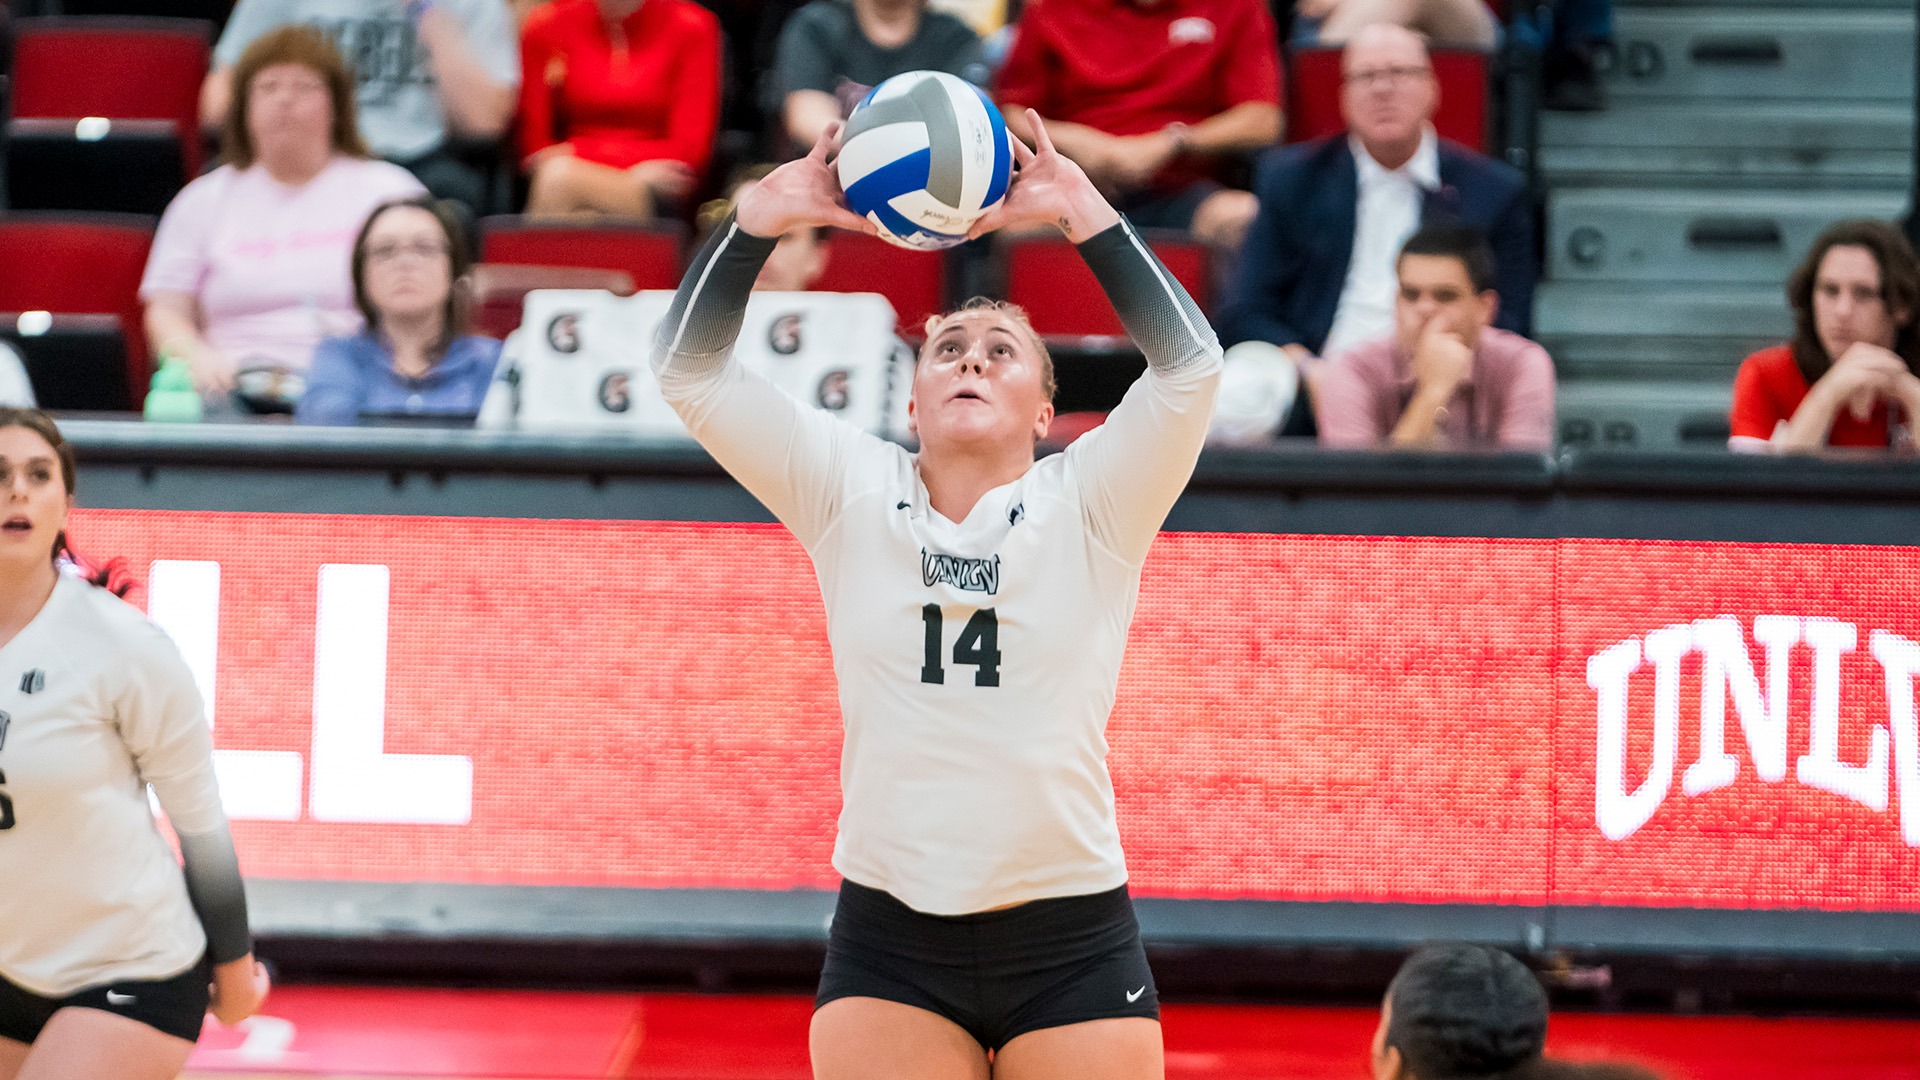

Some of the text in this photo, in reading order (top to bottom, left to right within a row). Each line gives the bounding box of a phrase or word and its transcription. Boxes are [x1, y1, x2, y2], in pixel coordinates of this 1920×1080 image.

[547, 312, 582, 353] G
[768, 312, 806, 355] G
[598, 370, 634, 413] G
[921, 546, 1001, 595] UNLV
[921, 602, 1001, 687] 14
